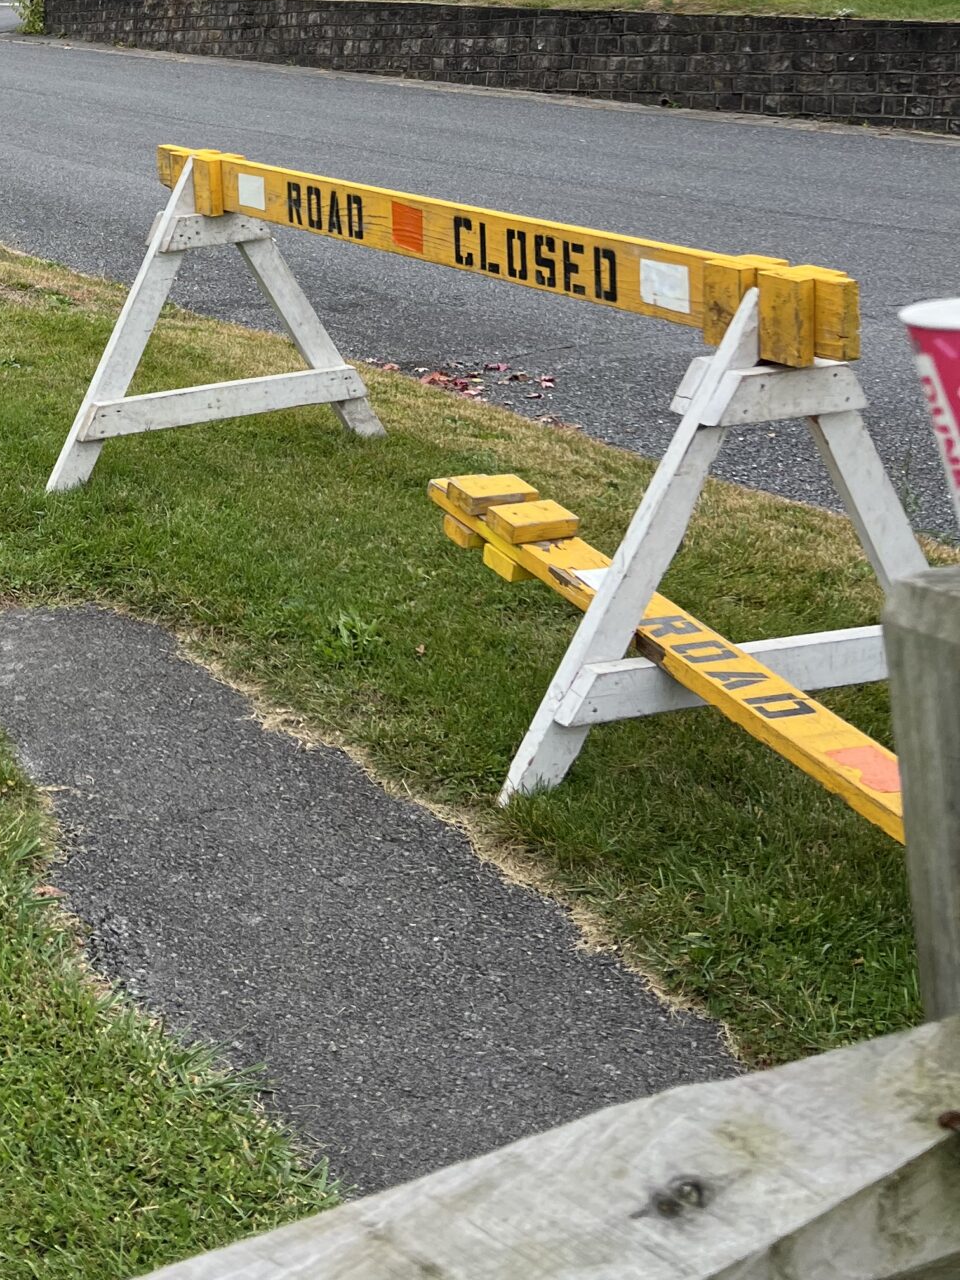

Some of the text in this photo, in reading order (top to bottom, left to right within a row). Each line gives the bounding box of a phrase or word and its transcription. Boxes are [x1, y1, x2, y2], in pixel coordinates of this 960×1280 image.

[287, 181, 618, 303] ROAD CLOSED
[641, 615, 817, 719] ROAD
